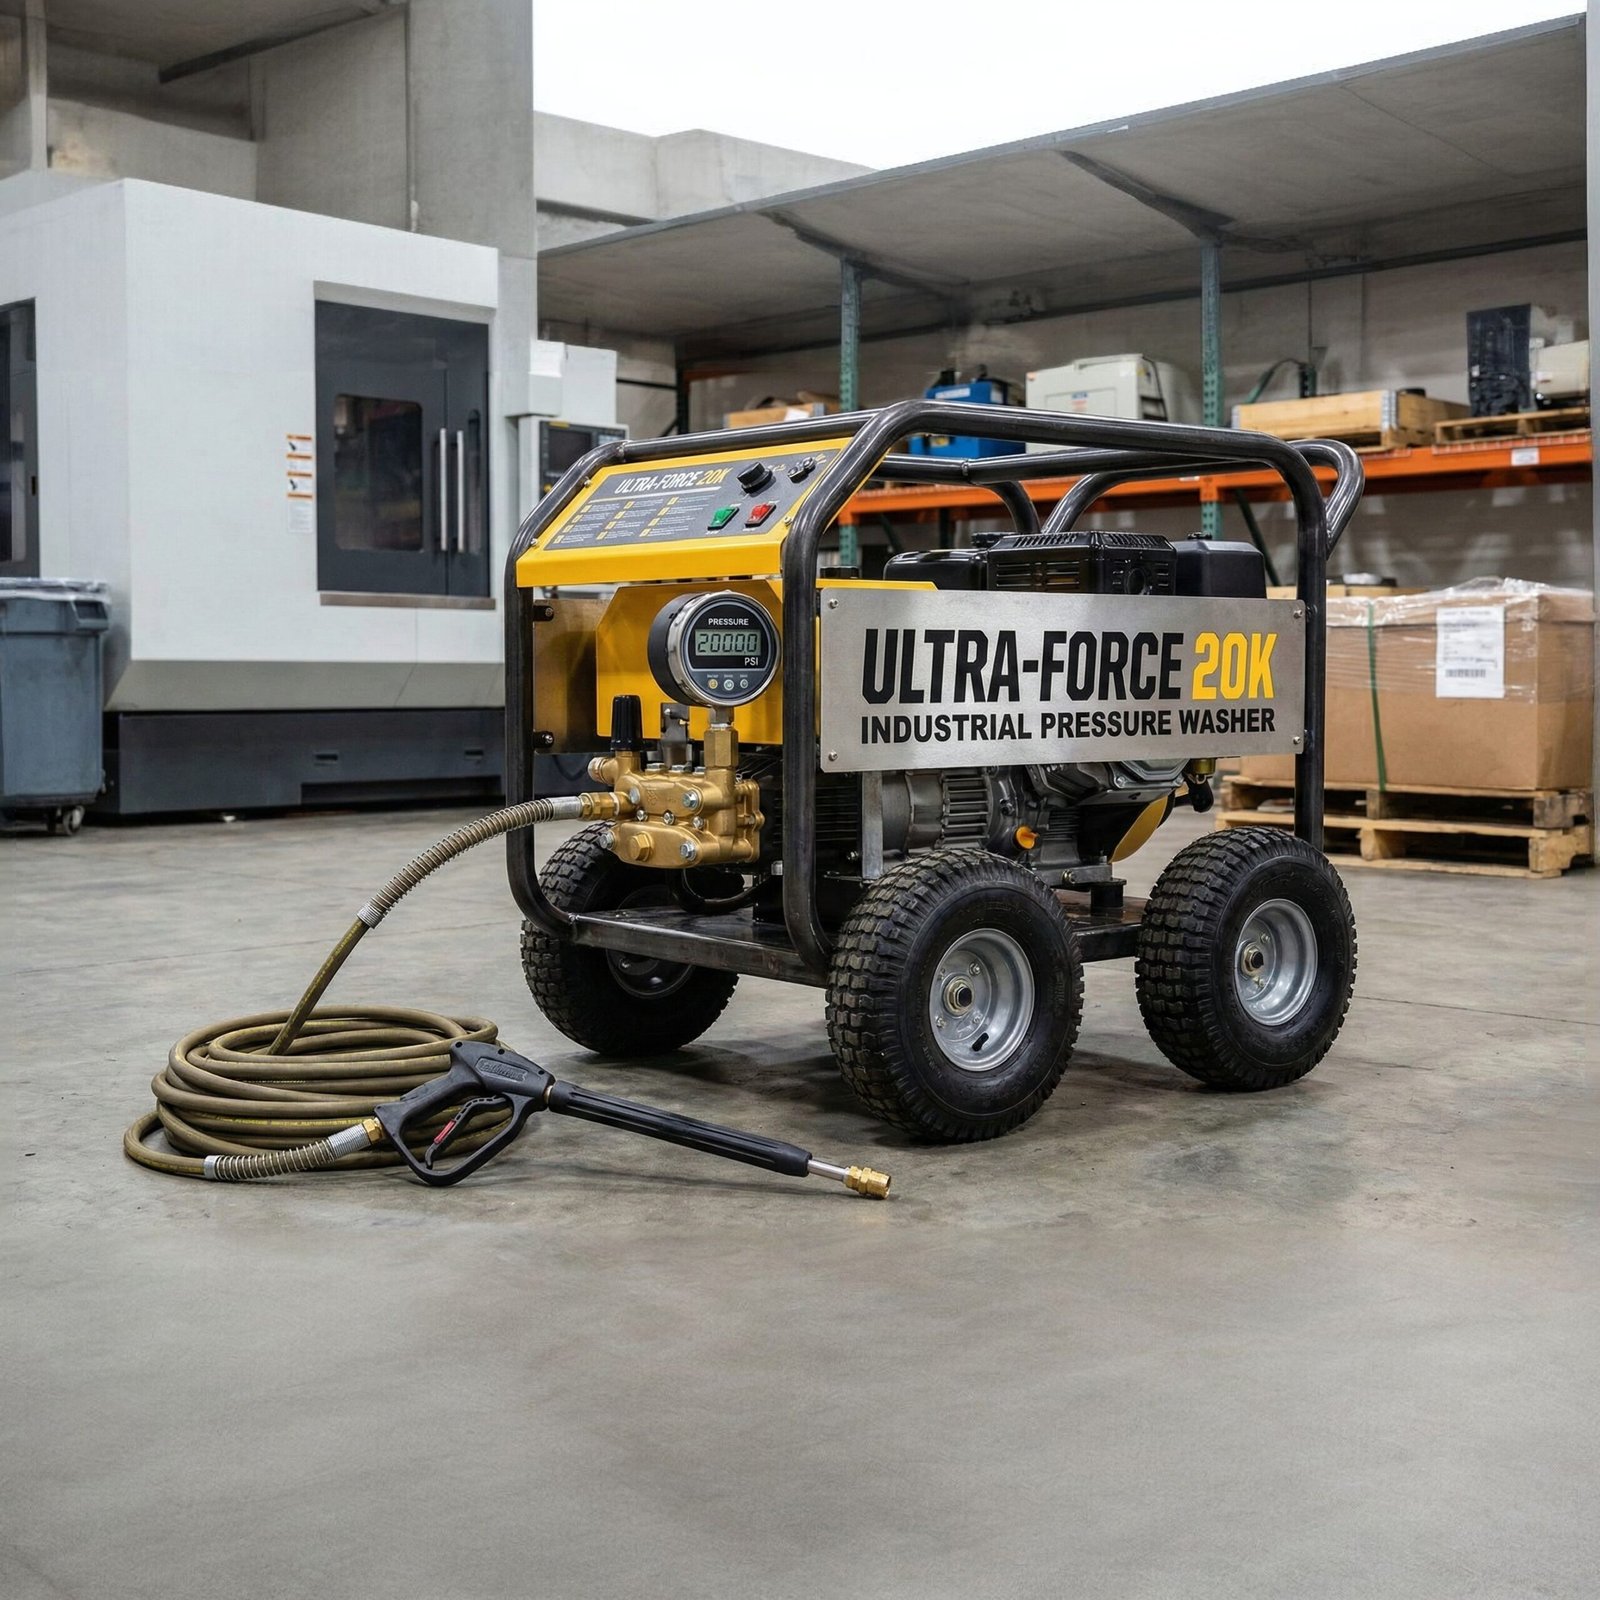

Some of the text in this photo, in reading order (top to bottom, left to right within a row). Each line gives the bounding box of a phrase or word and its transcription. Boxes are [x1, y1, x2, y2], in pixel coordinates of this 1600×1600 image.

[614, 468, 732, 493] ULTRA-FORCE 20K
[708, 618, 749, 626] PRESSURE
[744, 657, 759, 666] PSI
[862, 628, 1278, 704] ULTRA-FORCE 20K
[861, 707, 1276, 744] INDUSTRIAL PRESSURE WASHER
